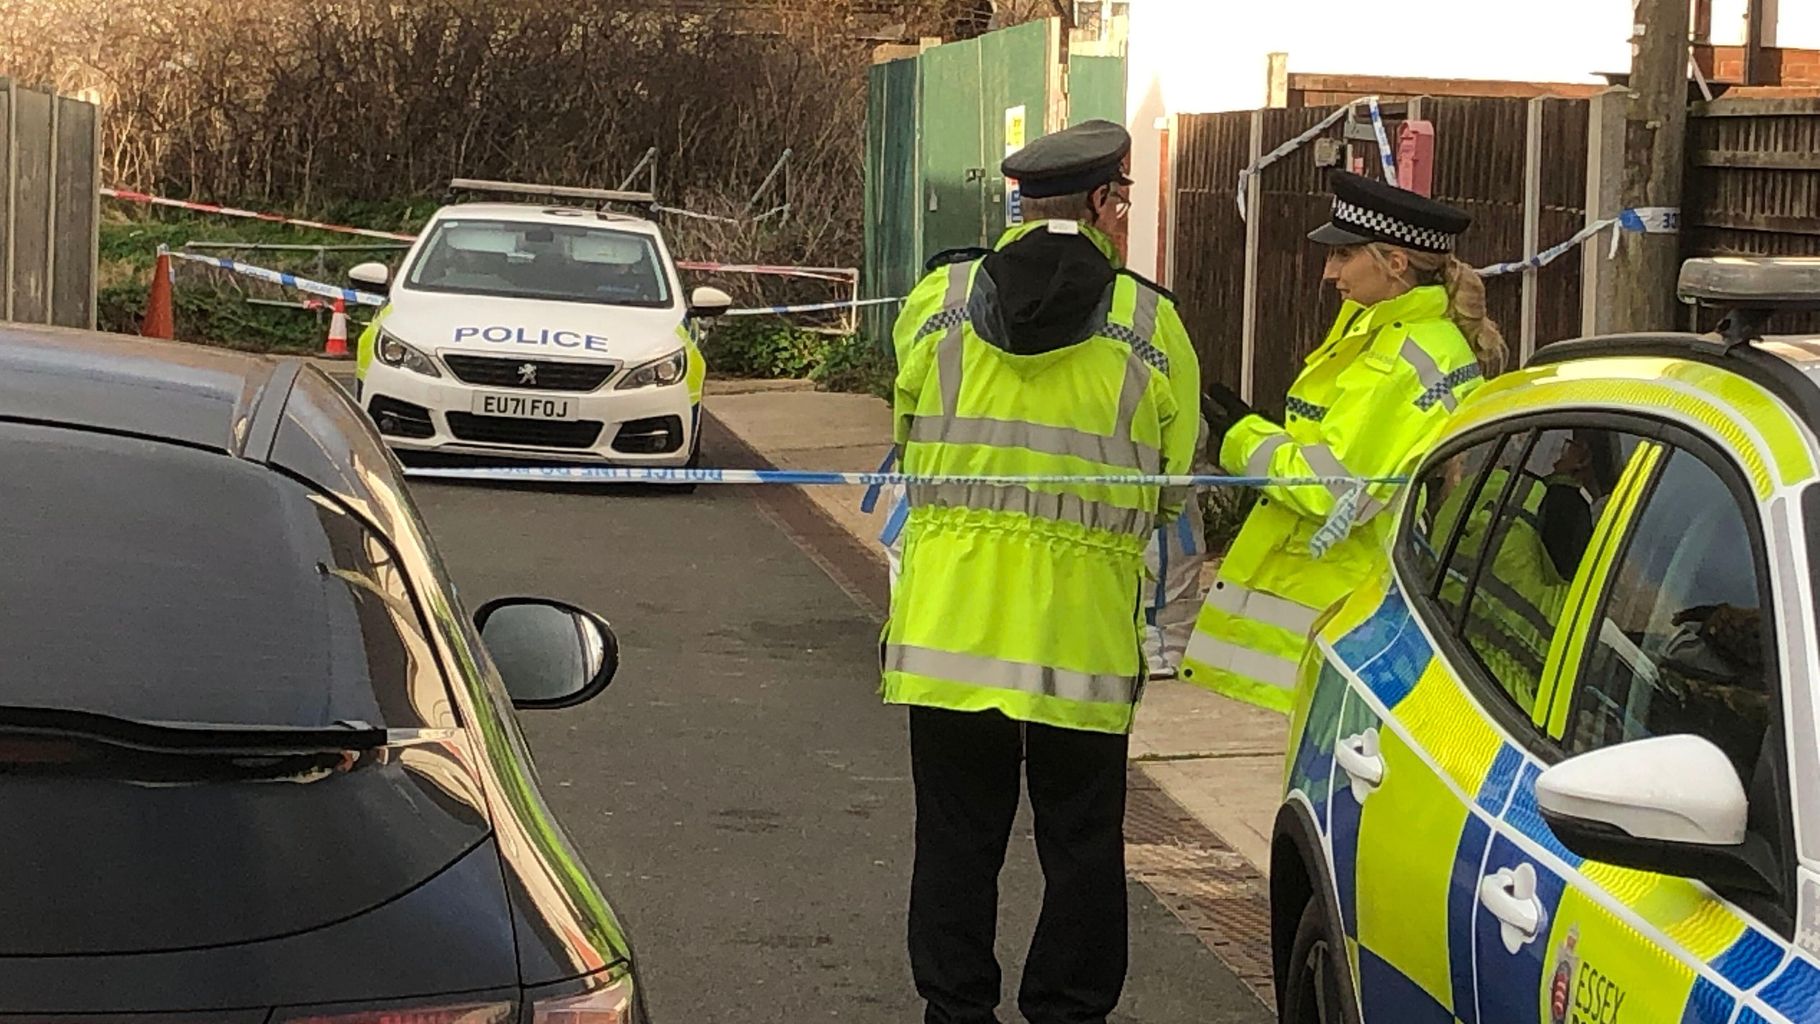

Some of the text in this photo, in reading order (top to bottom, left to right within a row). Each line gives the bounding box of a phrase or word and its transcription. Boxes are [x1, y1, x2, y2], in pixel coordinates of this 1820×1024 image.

[455, 326, 609, 352] POLICE
[484, 396, 568, 418] EU71 FOJ
[1575, 961, 1626, 1024] ESSEX
